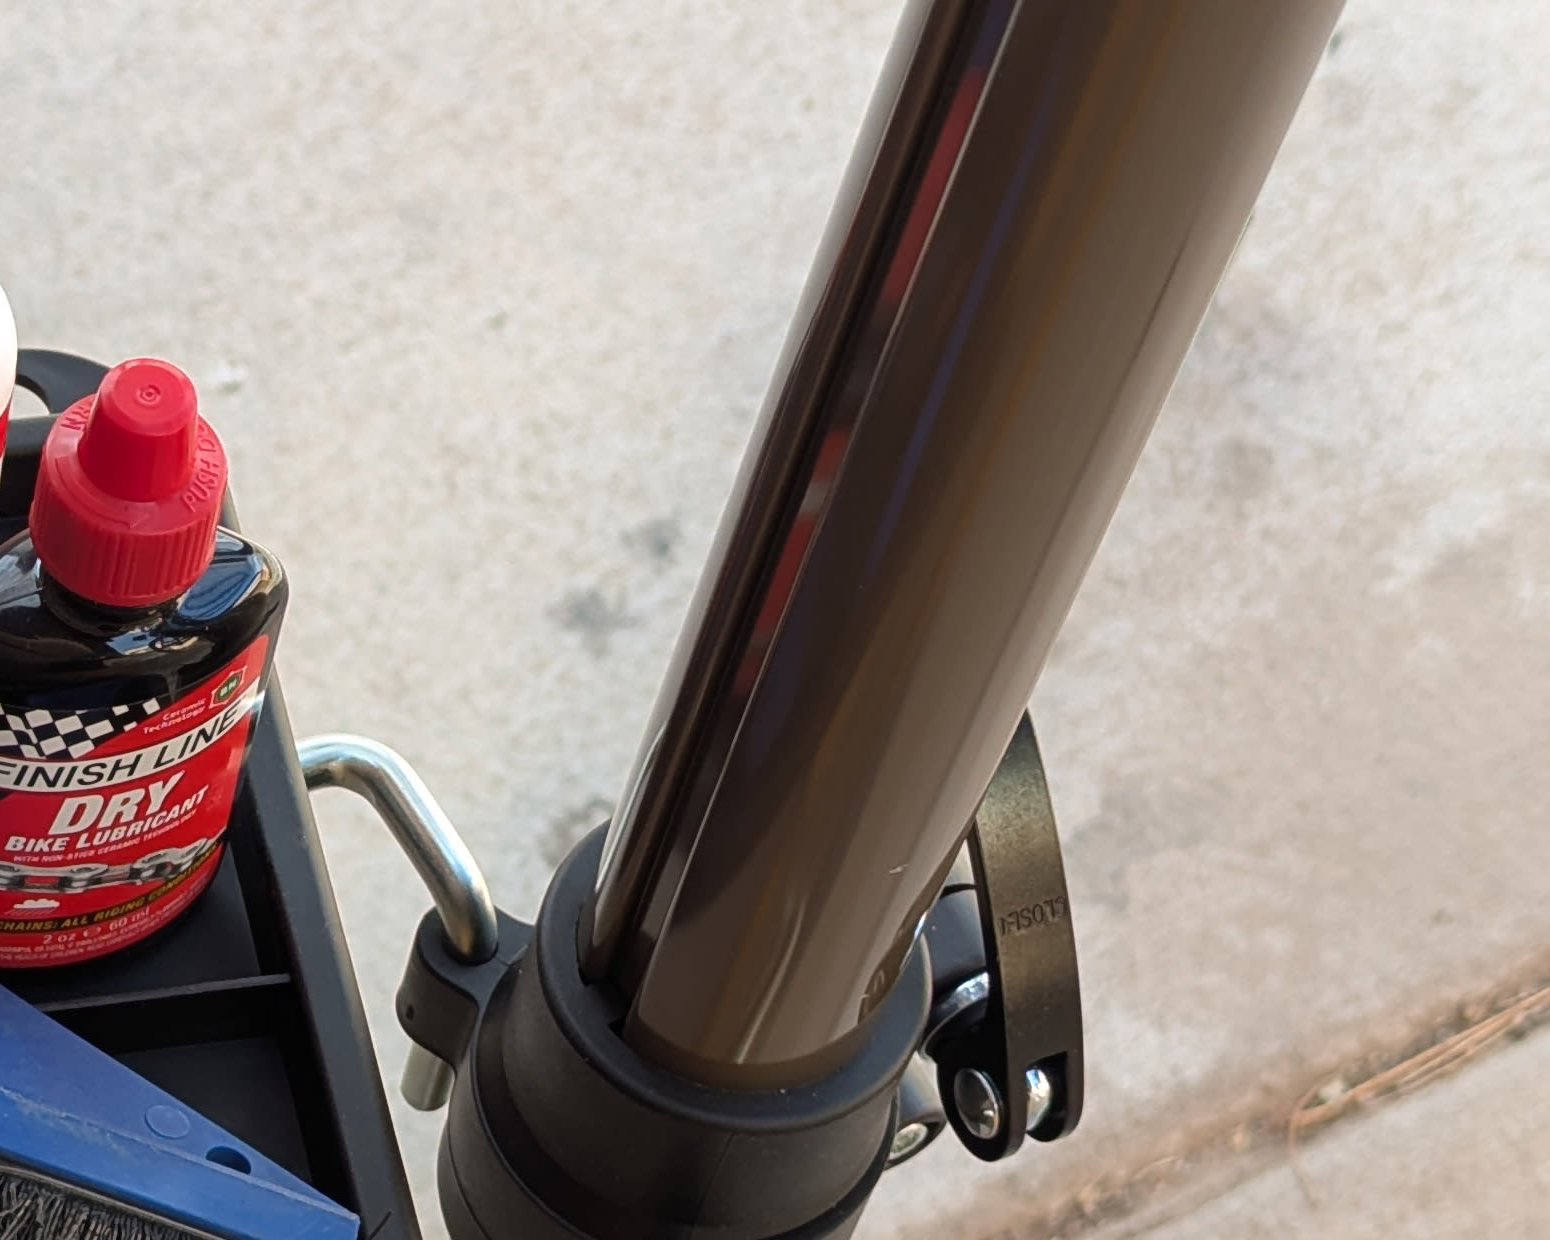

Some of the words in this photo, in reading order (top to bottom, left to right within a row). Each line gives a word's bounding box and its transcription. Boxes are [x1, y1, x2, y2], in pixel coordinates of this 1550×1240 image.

[181, 458, 219, 512] PUSH
[143, 705, 206, 734] Technology
[163, 698, 206, 721] Ceramic
[153, 699, 241, 771] LINE
[4, 835, 70, 852] BIKE
[75, 785, 209, 849] LUBRICANT
[48, 771, 186, 836] DRY
[42, 934, 52, 945] 2
[109, 917, 127, 932] 60
[61, 915, 89, 928] ALL
[93, 898, 146, 922] RIDING
